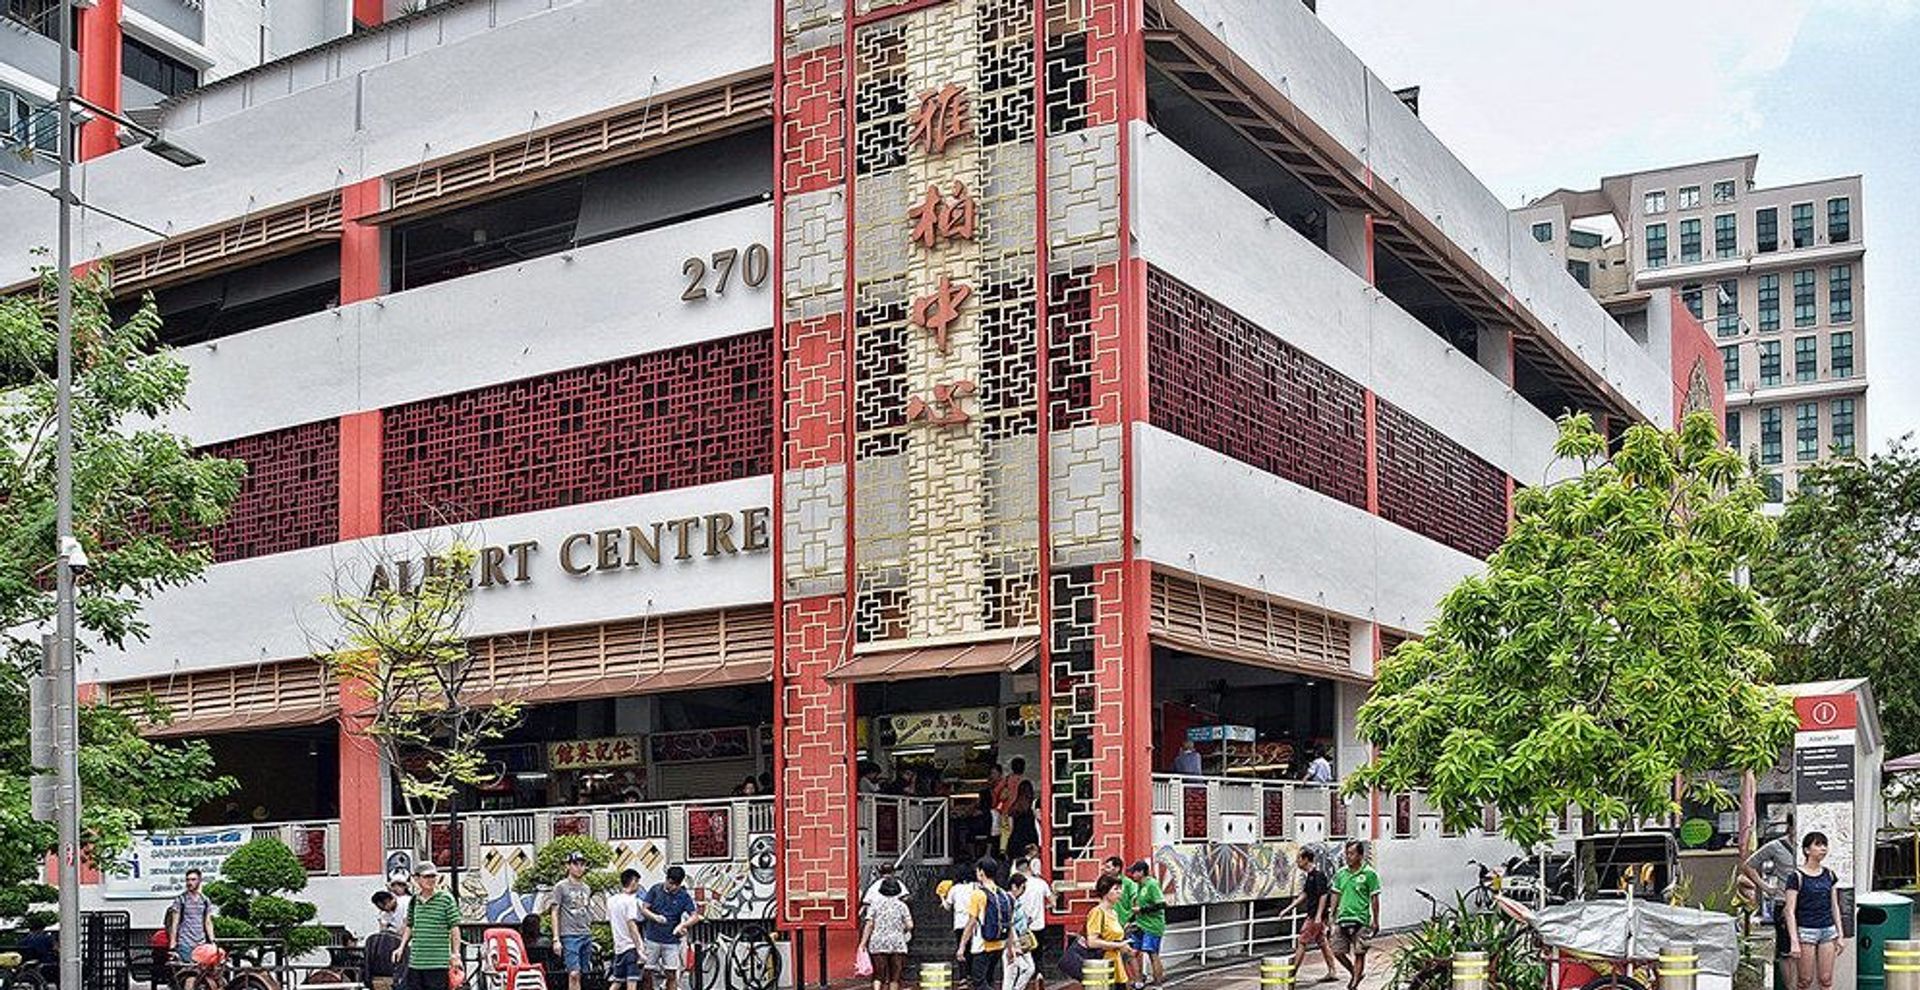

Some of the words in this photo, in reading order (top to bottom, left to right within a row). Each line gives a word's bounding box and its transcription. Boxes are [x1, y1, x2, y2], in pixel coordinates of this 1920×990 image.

[681, 243, 768, 301] 270
[908, 82, 978, 427] 雅柏中心
[559, 506, 770, 575] CENTRE
